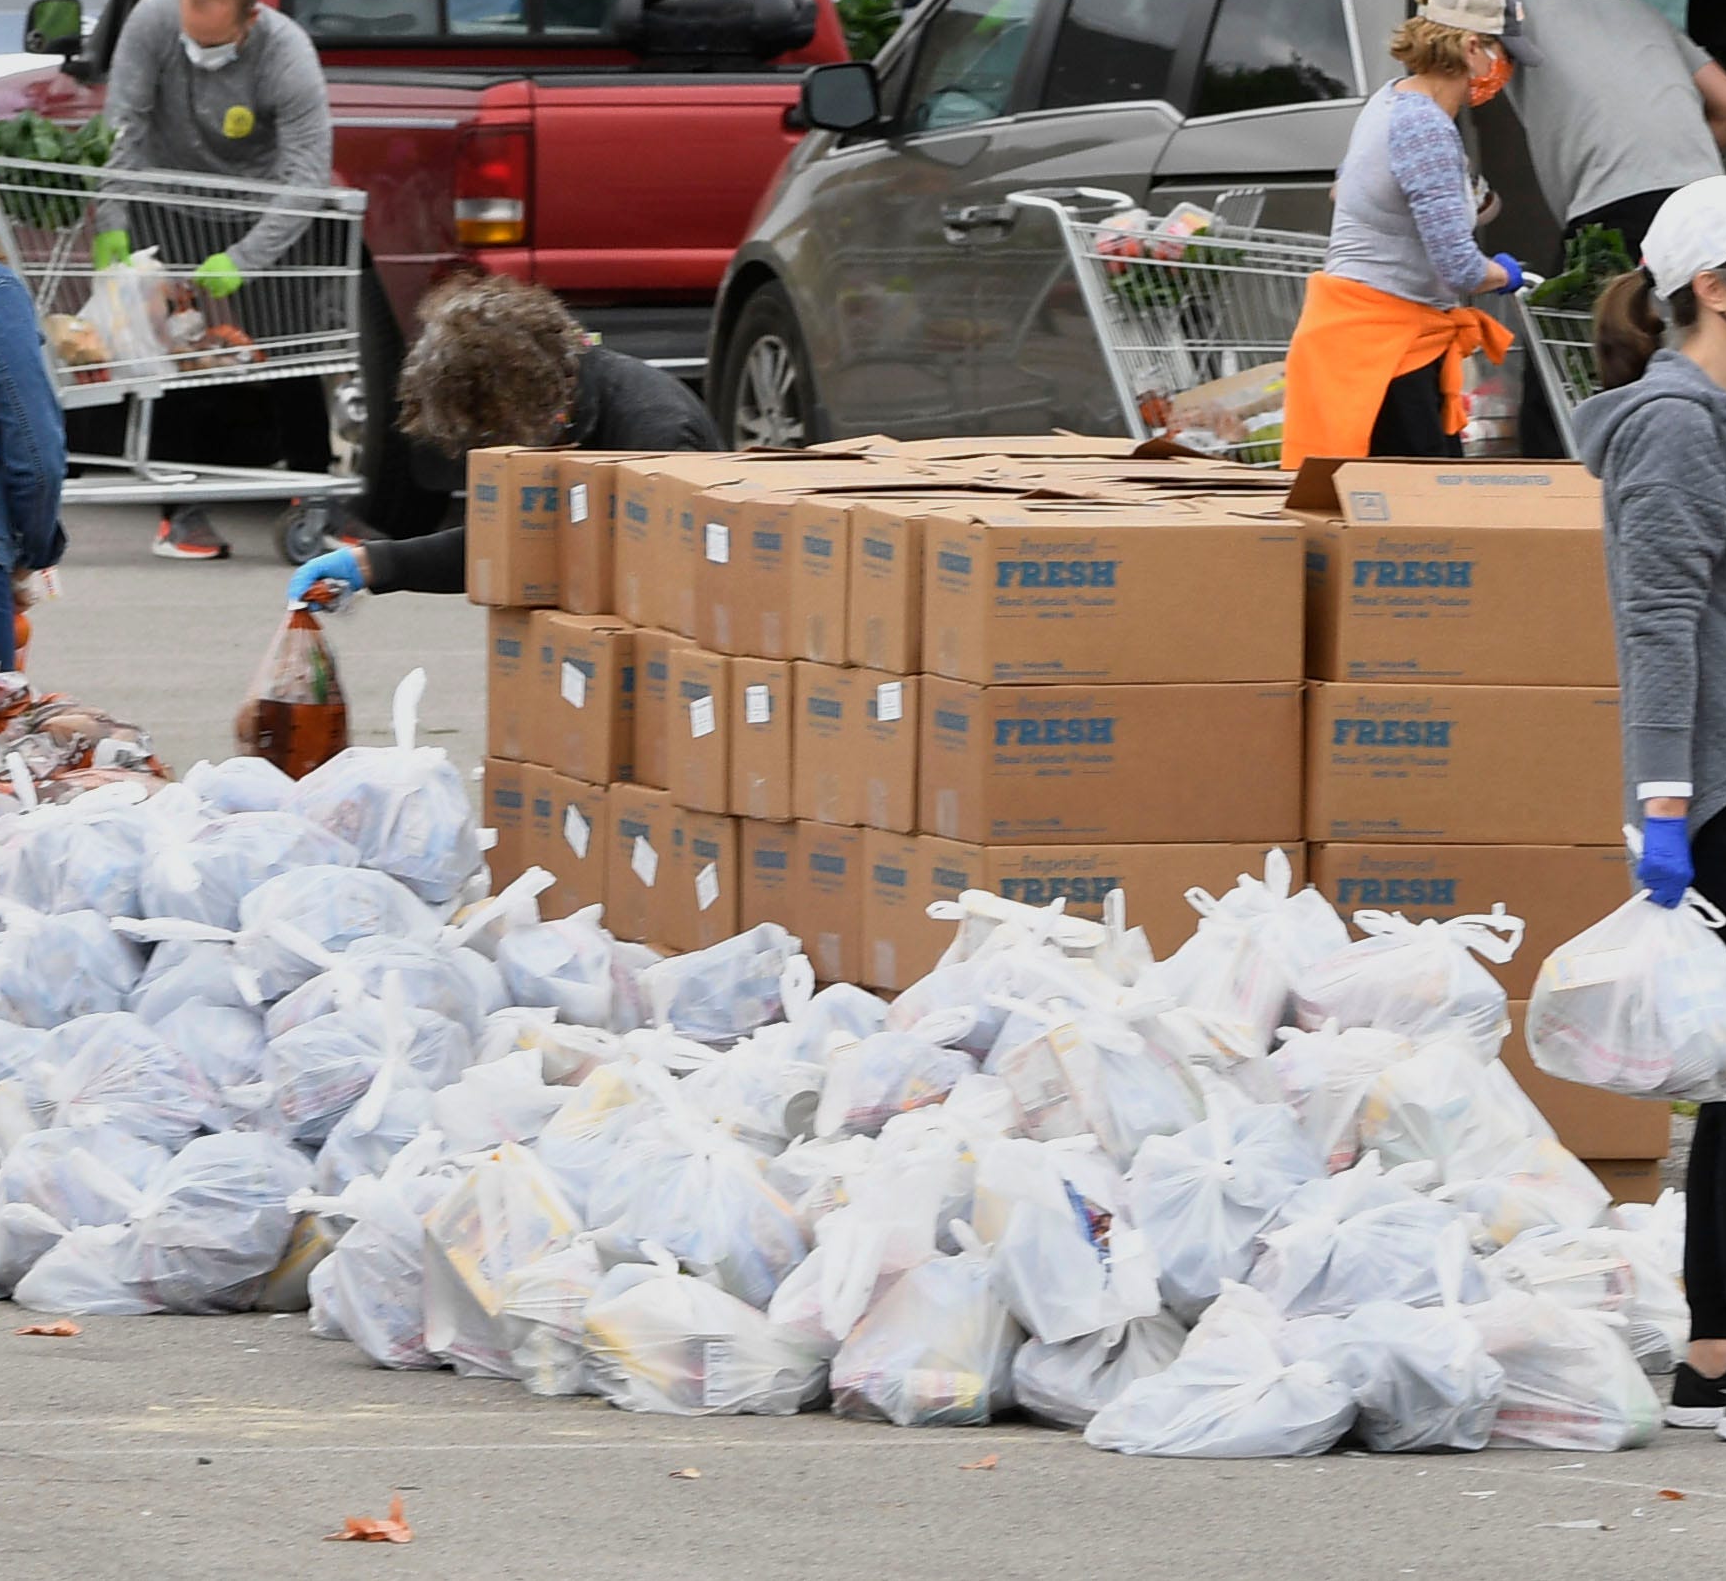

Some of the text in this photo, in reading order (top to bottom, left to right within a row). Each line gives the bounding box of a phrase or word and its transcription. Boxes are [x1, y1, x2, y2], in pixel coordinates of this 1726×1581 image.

[996, 560, 1117, 589] FRESH
[1352, 560, 1472, 588] FRESH
[994, 718, 1115, 746] FRESH
[1333, 719, 1452, 748] FRESH
[999, 876, 1121, 904] FRESH
[1336, 879, 1458, 905] FRESH
